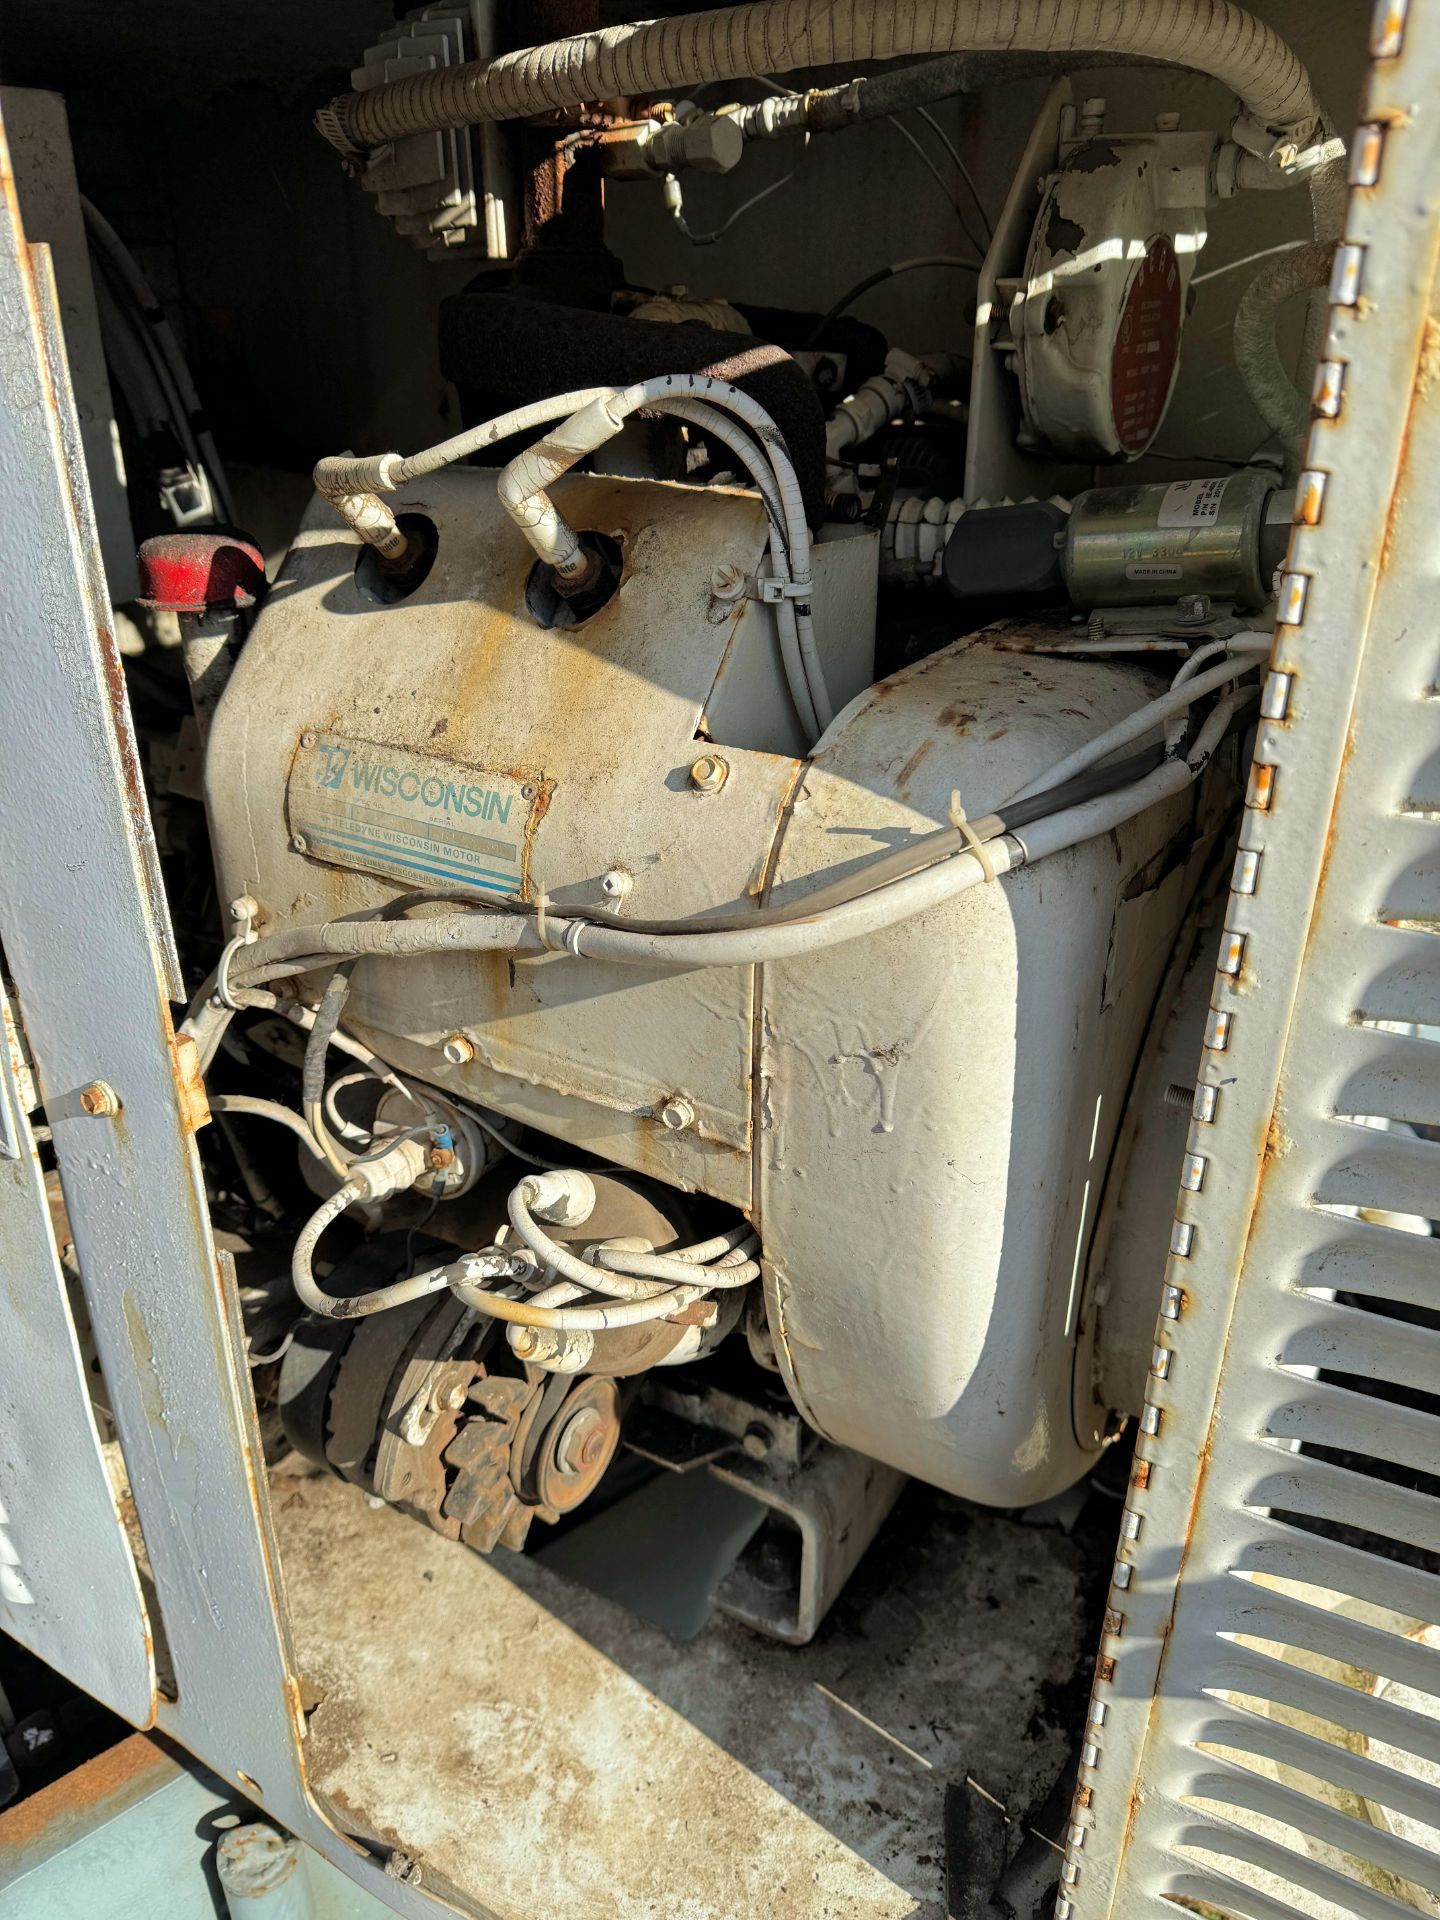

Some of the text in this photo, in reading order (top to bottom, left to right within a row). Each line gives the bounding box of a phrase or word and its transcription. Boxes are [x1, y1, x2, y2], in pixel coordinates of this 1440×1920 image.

[1192, 492, 1204, 516] MODEL
[352, 762, 514, 824] WISCONSIN
[428, 816, 456, 828] SERIAL
[335, 818, 381, 838] TELEDYNE
[383, 831, 440, 854] WISCONSIN
[443, 846, 481, 864] MOTOR
